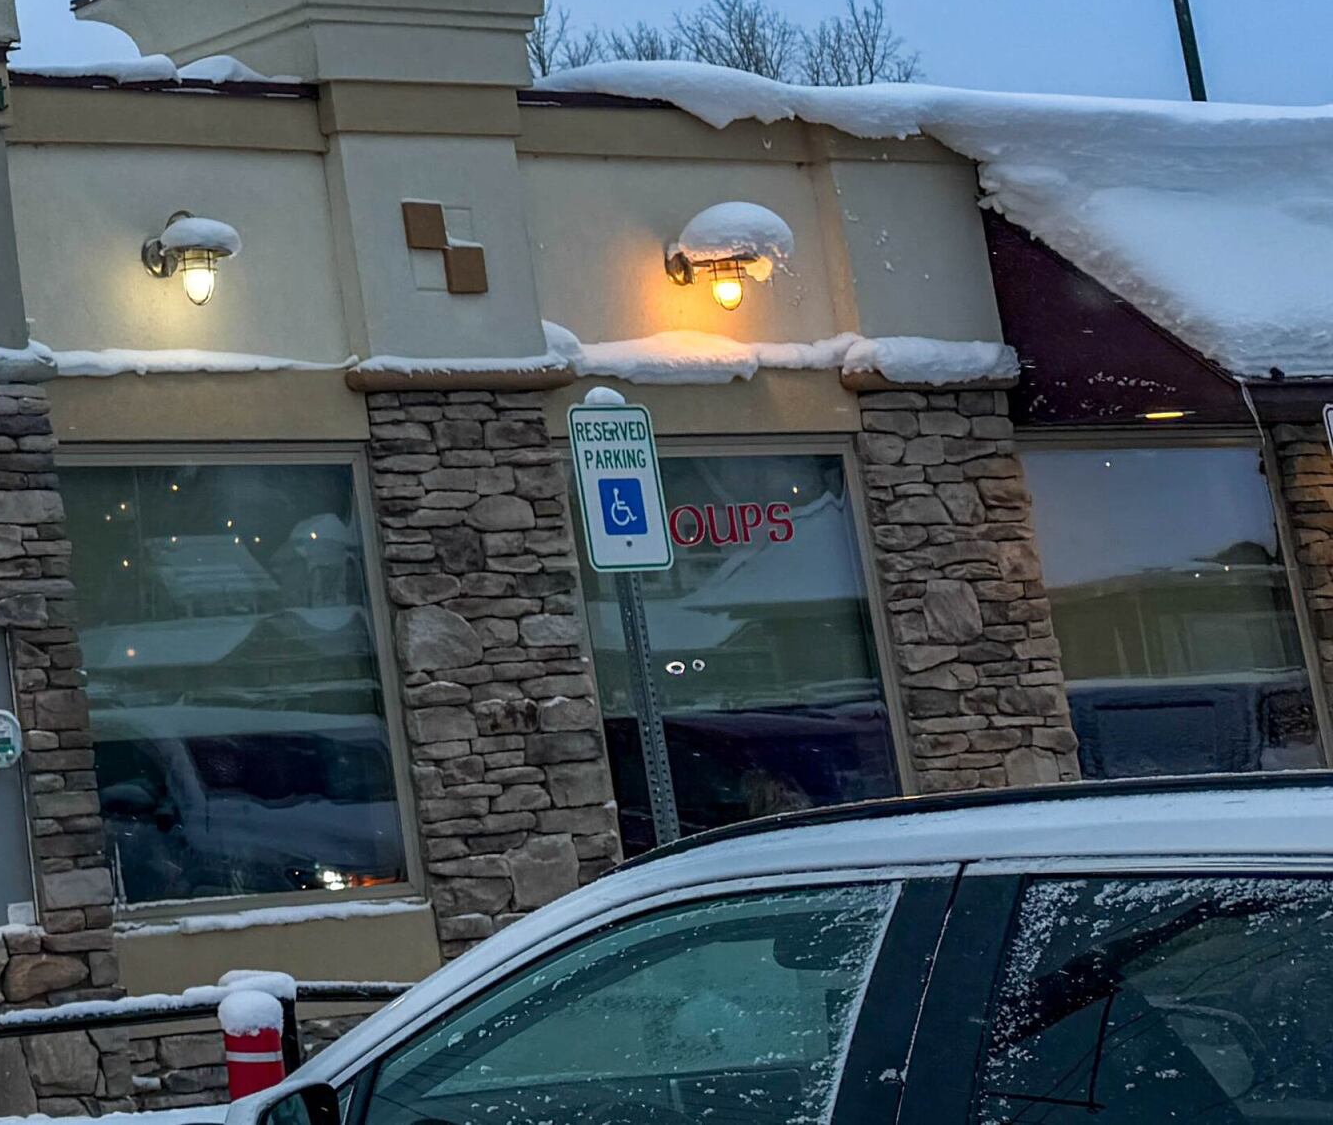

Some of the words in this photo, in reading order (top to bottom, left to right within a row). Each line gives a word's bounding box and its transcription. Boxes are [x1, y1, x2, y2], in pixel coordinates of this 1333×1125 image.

[575, 421, 646, 442] RESERVED
[584, 449, 646, 469] PARKING
[669, 502, 795, 546] OUPS
